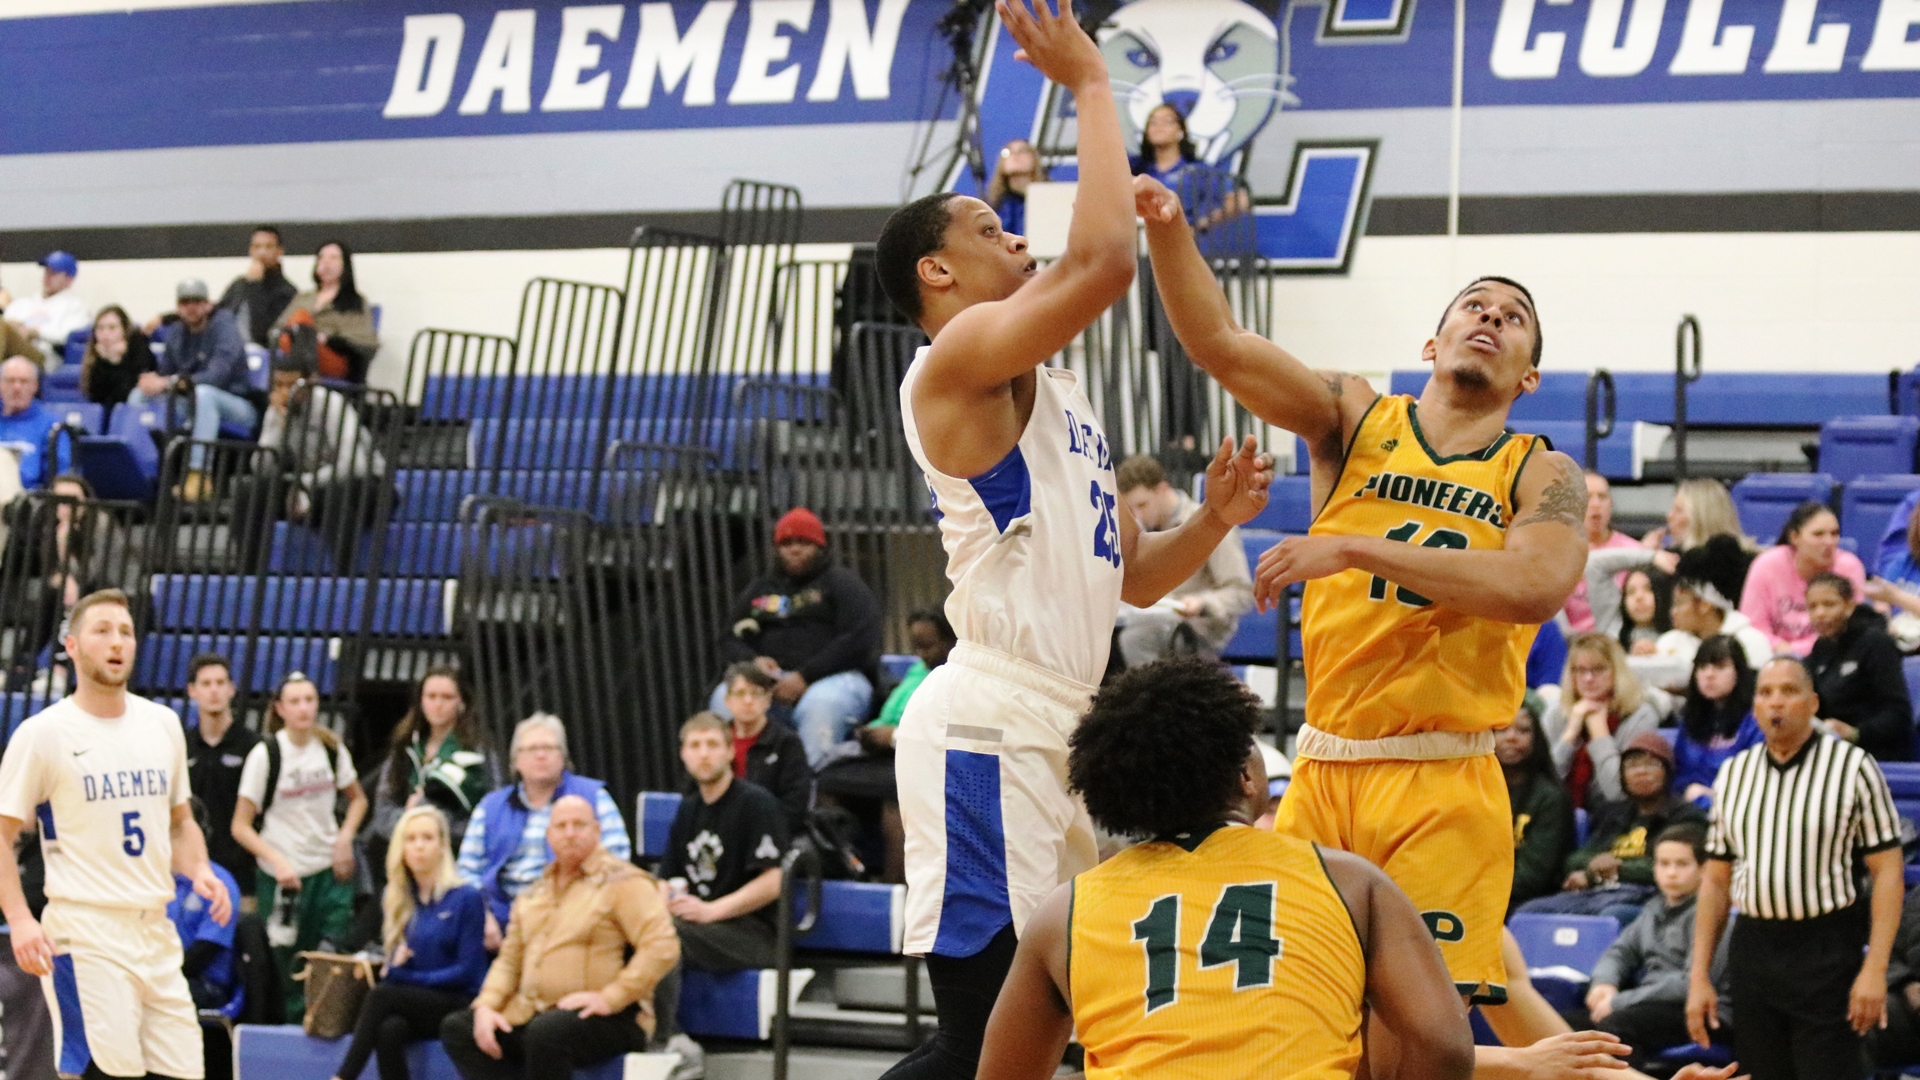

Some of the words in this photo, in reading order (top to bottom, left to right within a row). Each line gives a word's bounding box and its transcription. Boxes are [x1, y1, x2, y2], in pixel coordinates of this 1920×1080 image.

[382, 0, 908, 119] DAEMEN
[1090, 480, 1121, 569] 25
[83, 769, 168, 802] DAEMEN
[121, 811, 146, 857] 5
[1130, 880, 1284, 1018] 14
